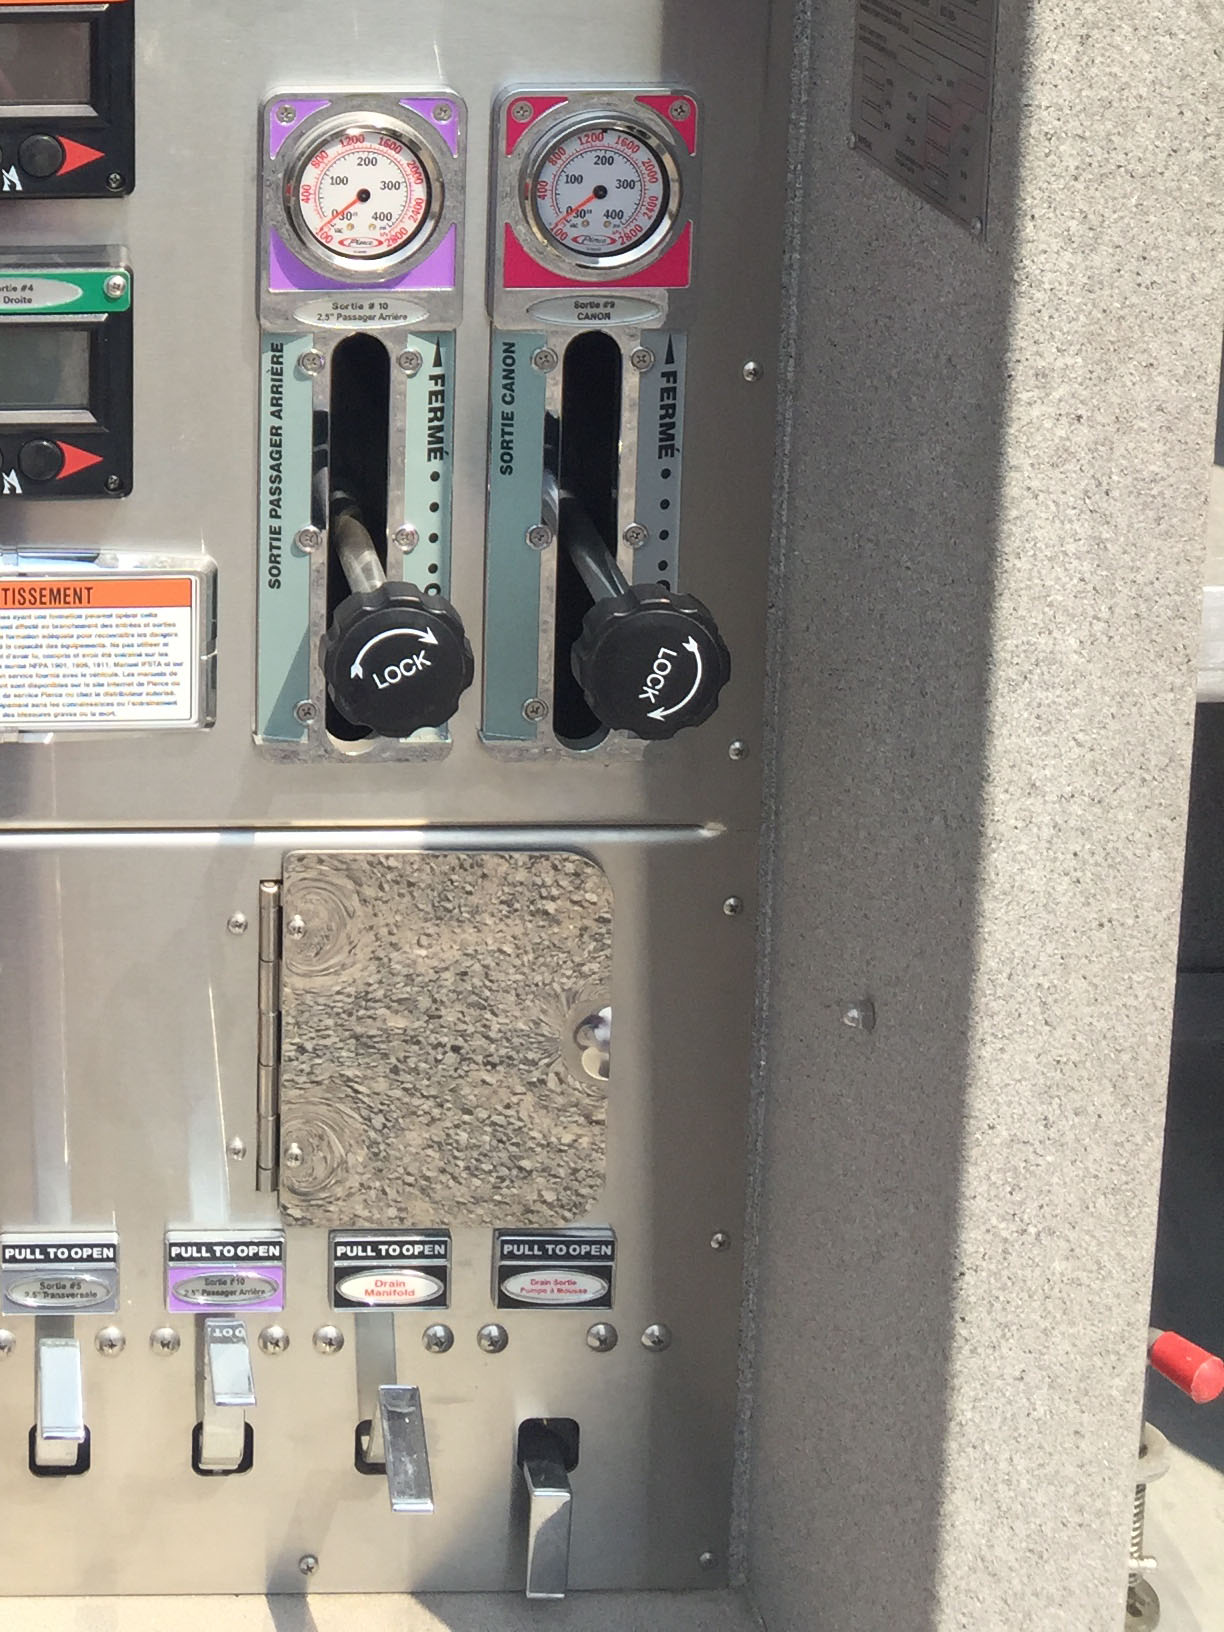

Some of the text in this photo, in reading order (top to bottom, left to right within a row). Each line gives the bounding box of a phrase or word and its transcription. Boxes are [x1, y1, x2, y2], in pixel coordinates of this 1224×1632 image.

[21, 284, 33, 292] #4
[4, 296, 32, 304] Droite
[499, 341, 516, 475] SORTIE CANON
[427, 374, 449, 463] FERMÉ
[658, 371, 682, 460] FERMÉ
[266, 342, 285, 589] SORTIE PASSAGER ARRIÈRE
[373, 651, 432, 689] LOCK
[639, 647, 677, 703] LOCK
[5, 1248, 114, 1259] PULL TO OPEN
[171, 1246, 280, 1257] PULL TO OPEN
[337, 1244, 445, 1256] PULL TO OPEN
[504, 1244, 611, 1255] PULL TO OPEN
[365, 1289, 415, 1297] Manifold
